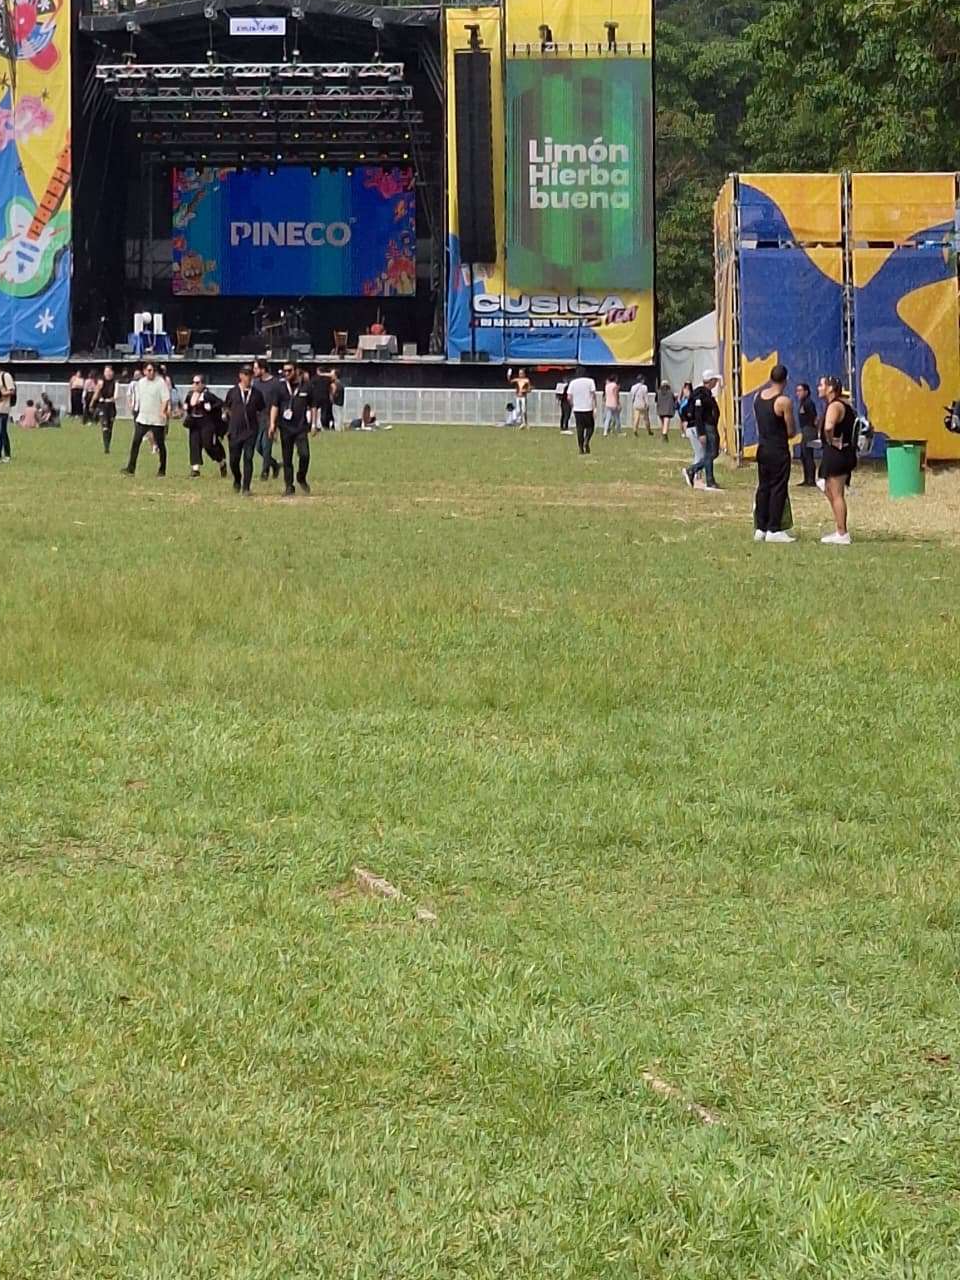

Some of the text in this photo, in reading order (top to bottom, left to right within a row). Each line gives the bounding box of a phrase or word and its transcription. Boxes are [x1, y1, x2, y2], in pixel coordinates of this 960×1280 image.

[528, 136, 629, 163] Limón
[529, 162, 629, 186] Hierba
[529, 186, 630, 209] buena
[230, 221, 351, 247] PINECO
[473, 294, 625, 315] CUSICA
[493, 318, 530, 327] MUSIC
[532, 318, 550, 327] WE
